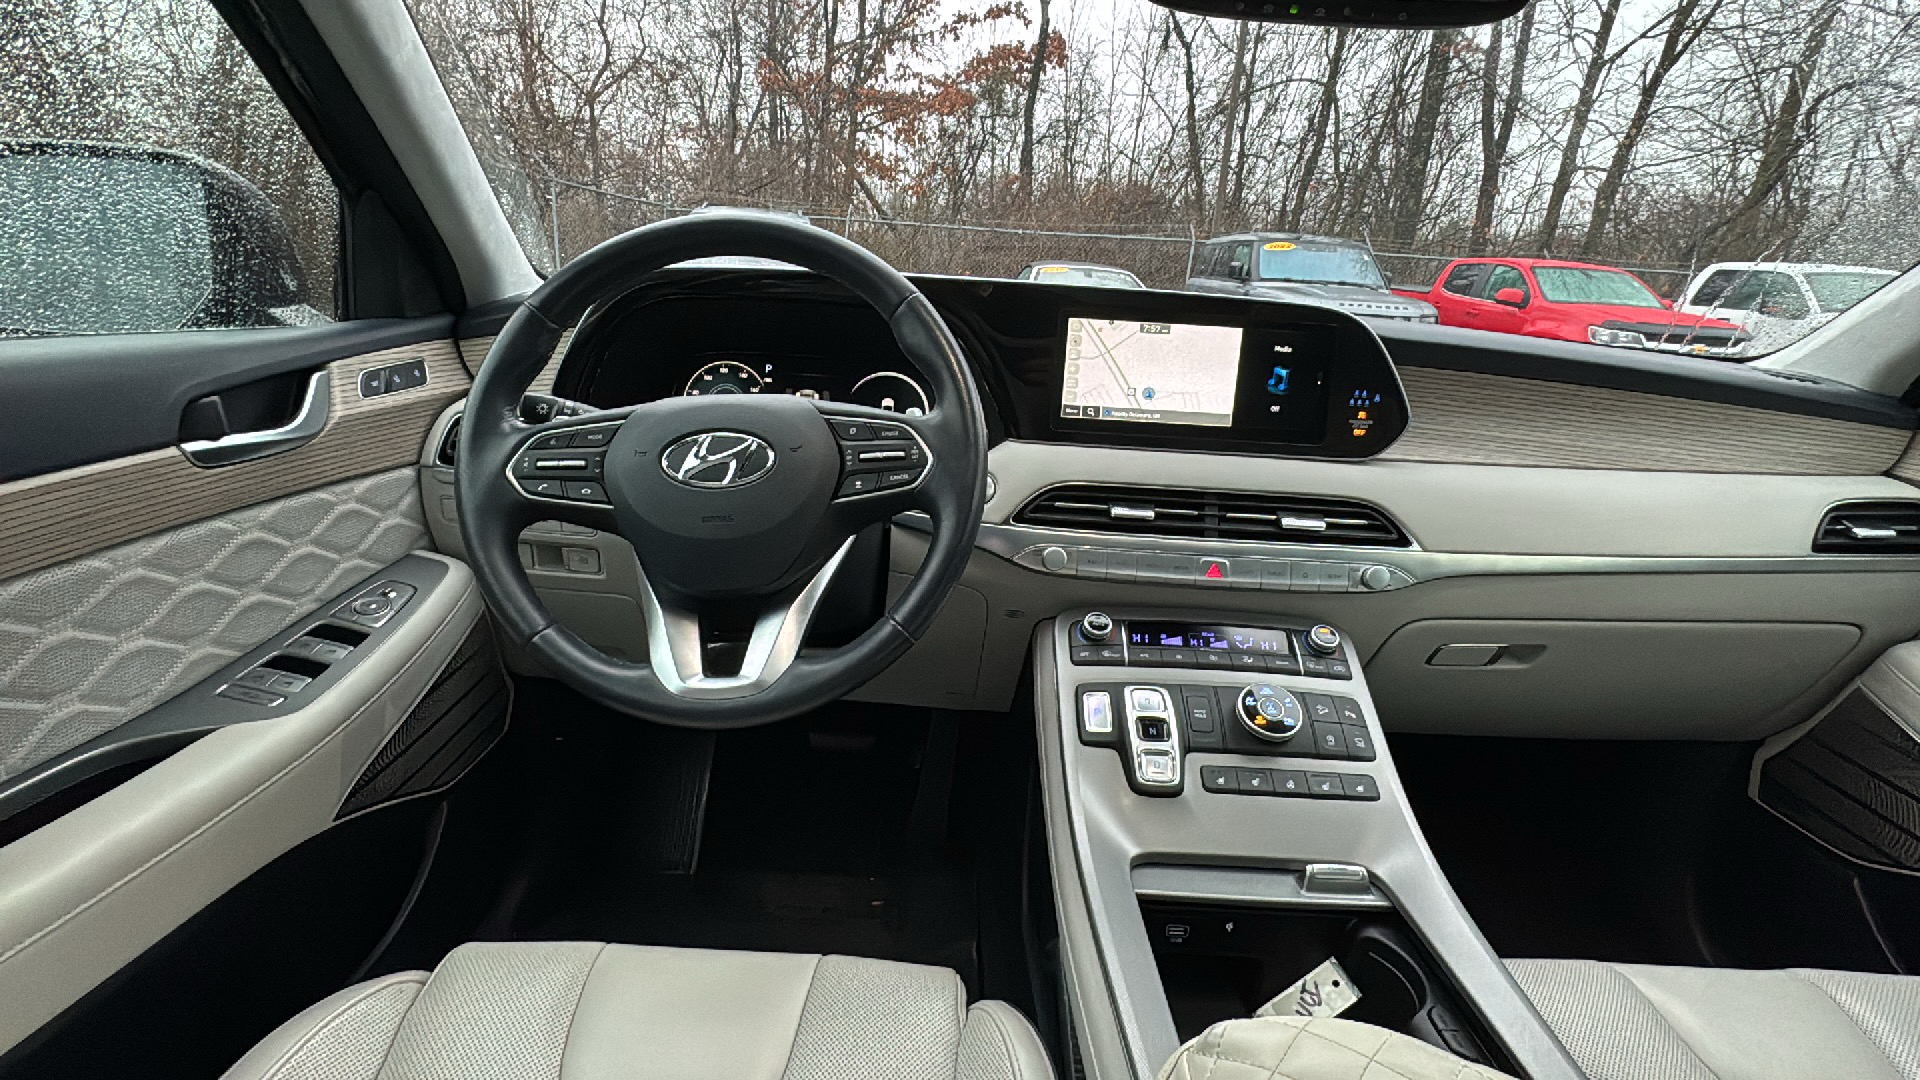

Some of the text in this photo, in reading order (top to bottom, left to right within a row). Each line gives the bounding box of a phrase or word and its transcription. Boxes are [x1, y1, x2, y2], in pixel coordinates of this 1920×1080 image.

[1143, 324, 1161, 333] 7:57
[1274, 345, 1293, 353] Media
[765, 363, 773, 374] P
[1149, 727, 1157, 735] N
